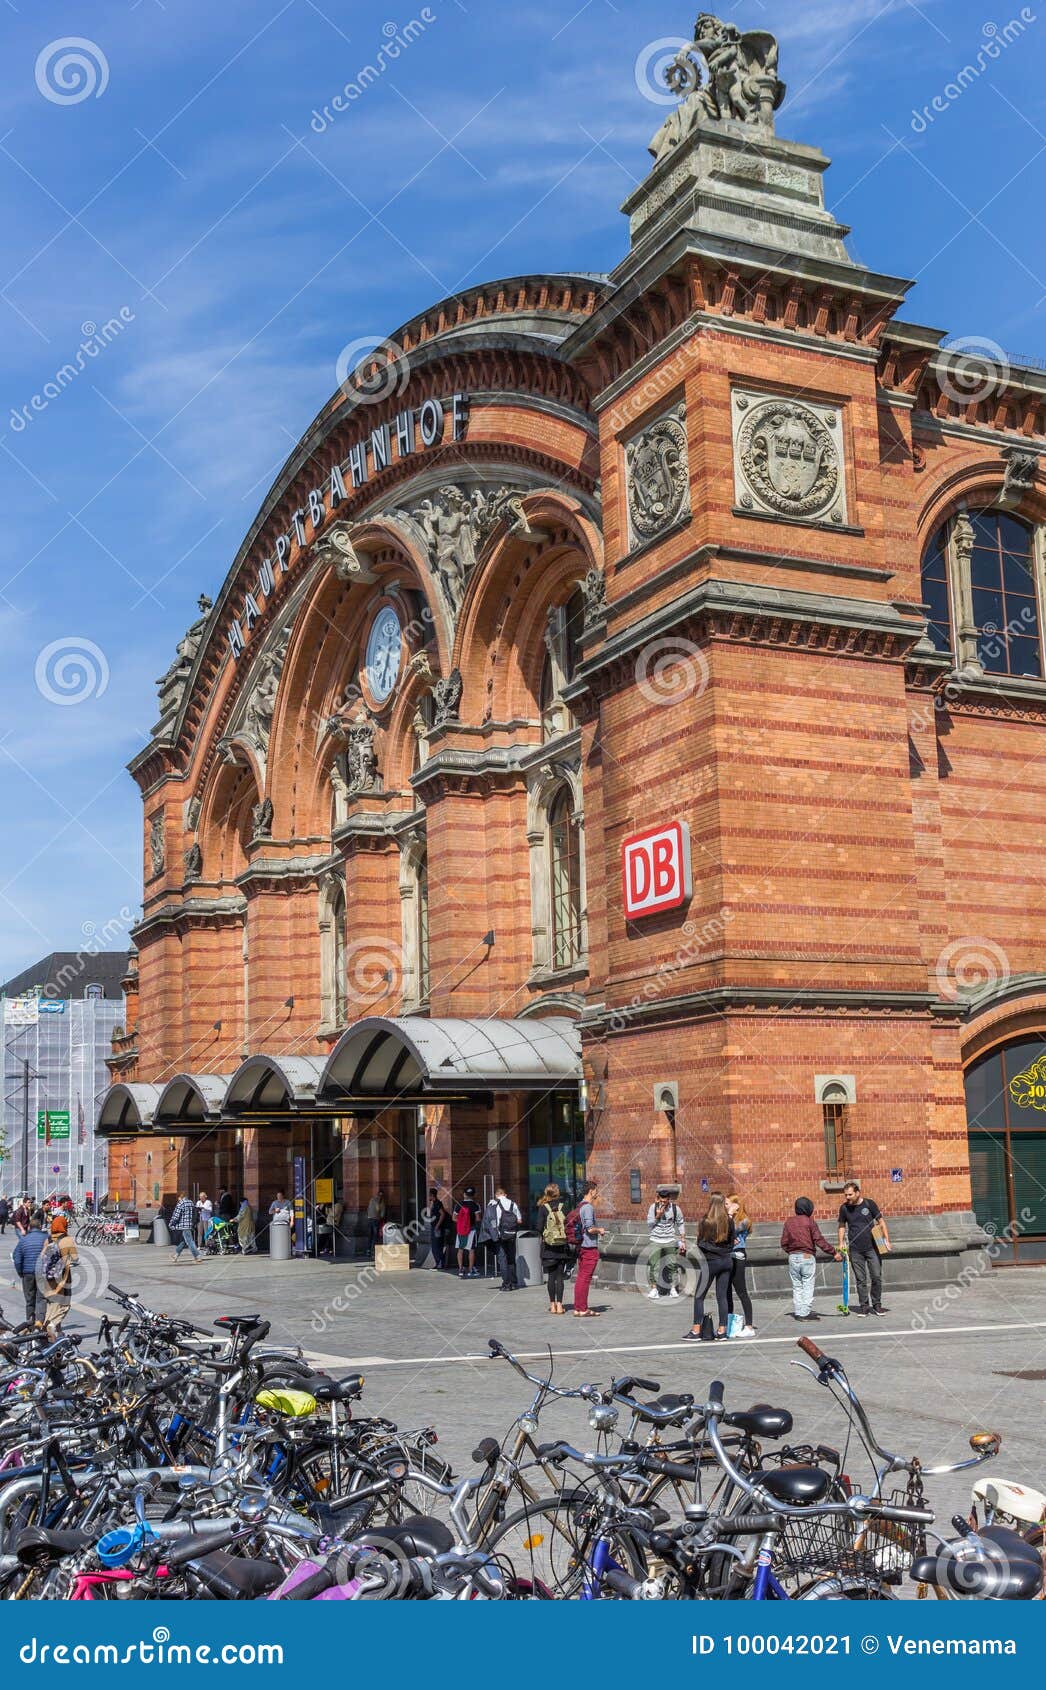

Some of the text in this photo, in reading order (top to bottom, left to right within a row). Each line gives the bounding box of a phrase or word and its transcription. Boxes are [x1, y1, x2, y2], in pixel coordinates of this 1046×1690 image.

[227, 392, 471, 658] HAUPTBAHNHOF
[629, 838, 676, 904] DB
[1028, 1085, 1046, 1097] JO
